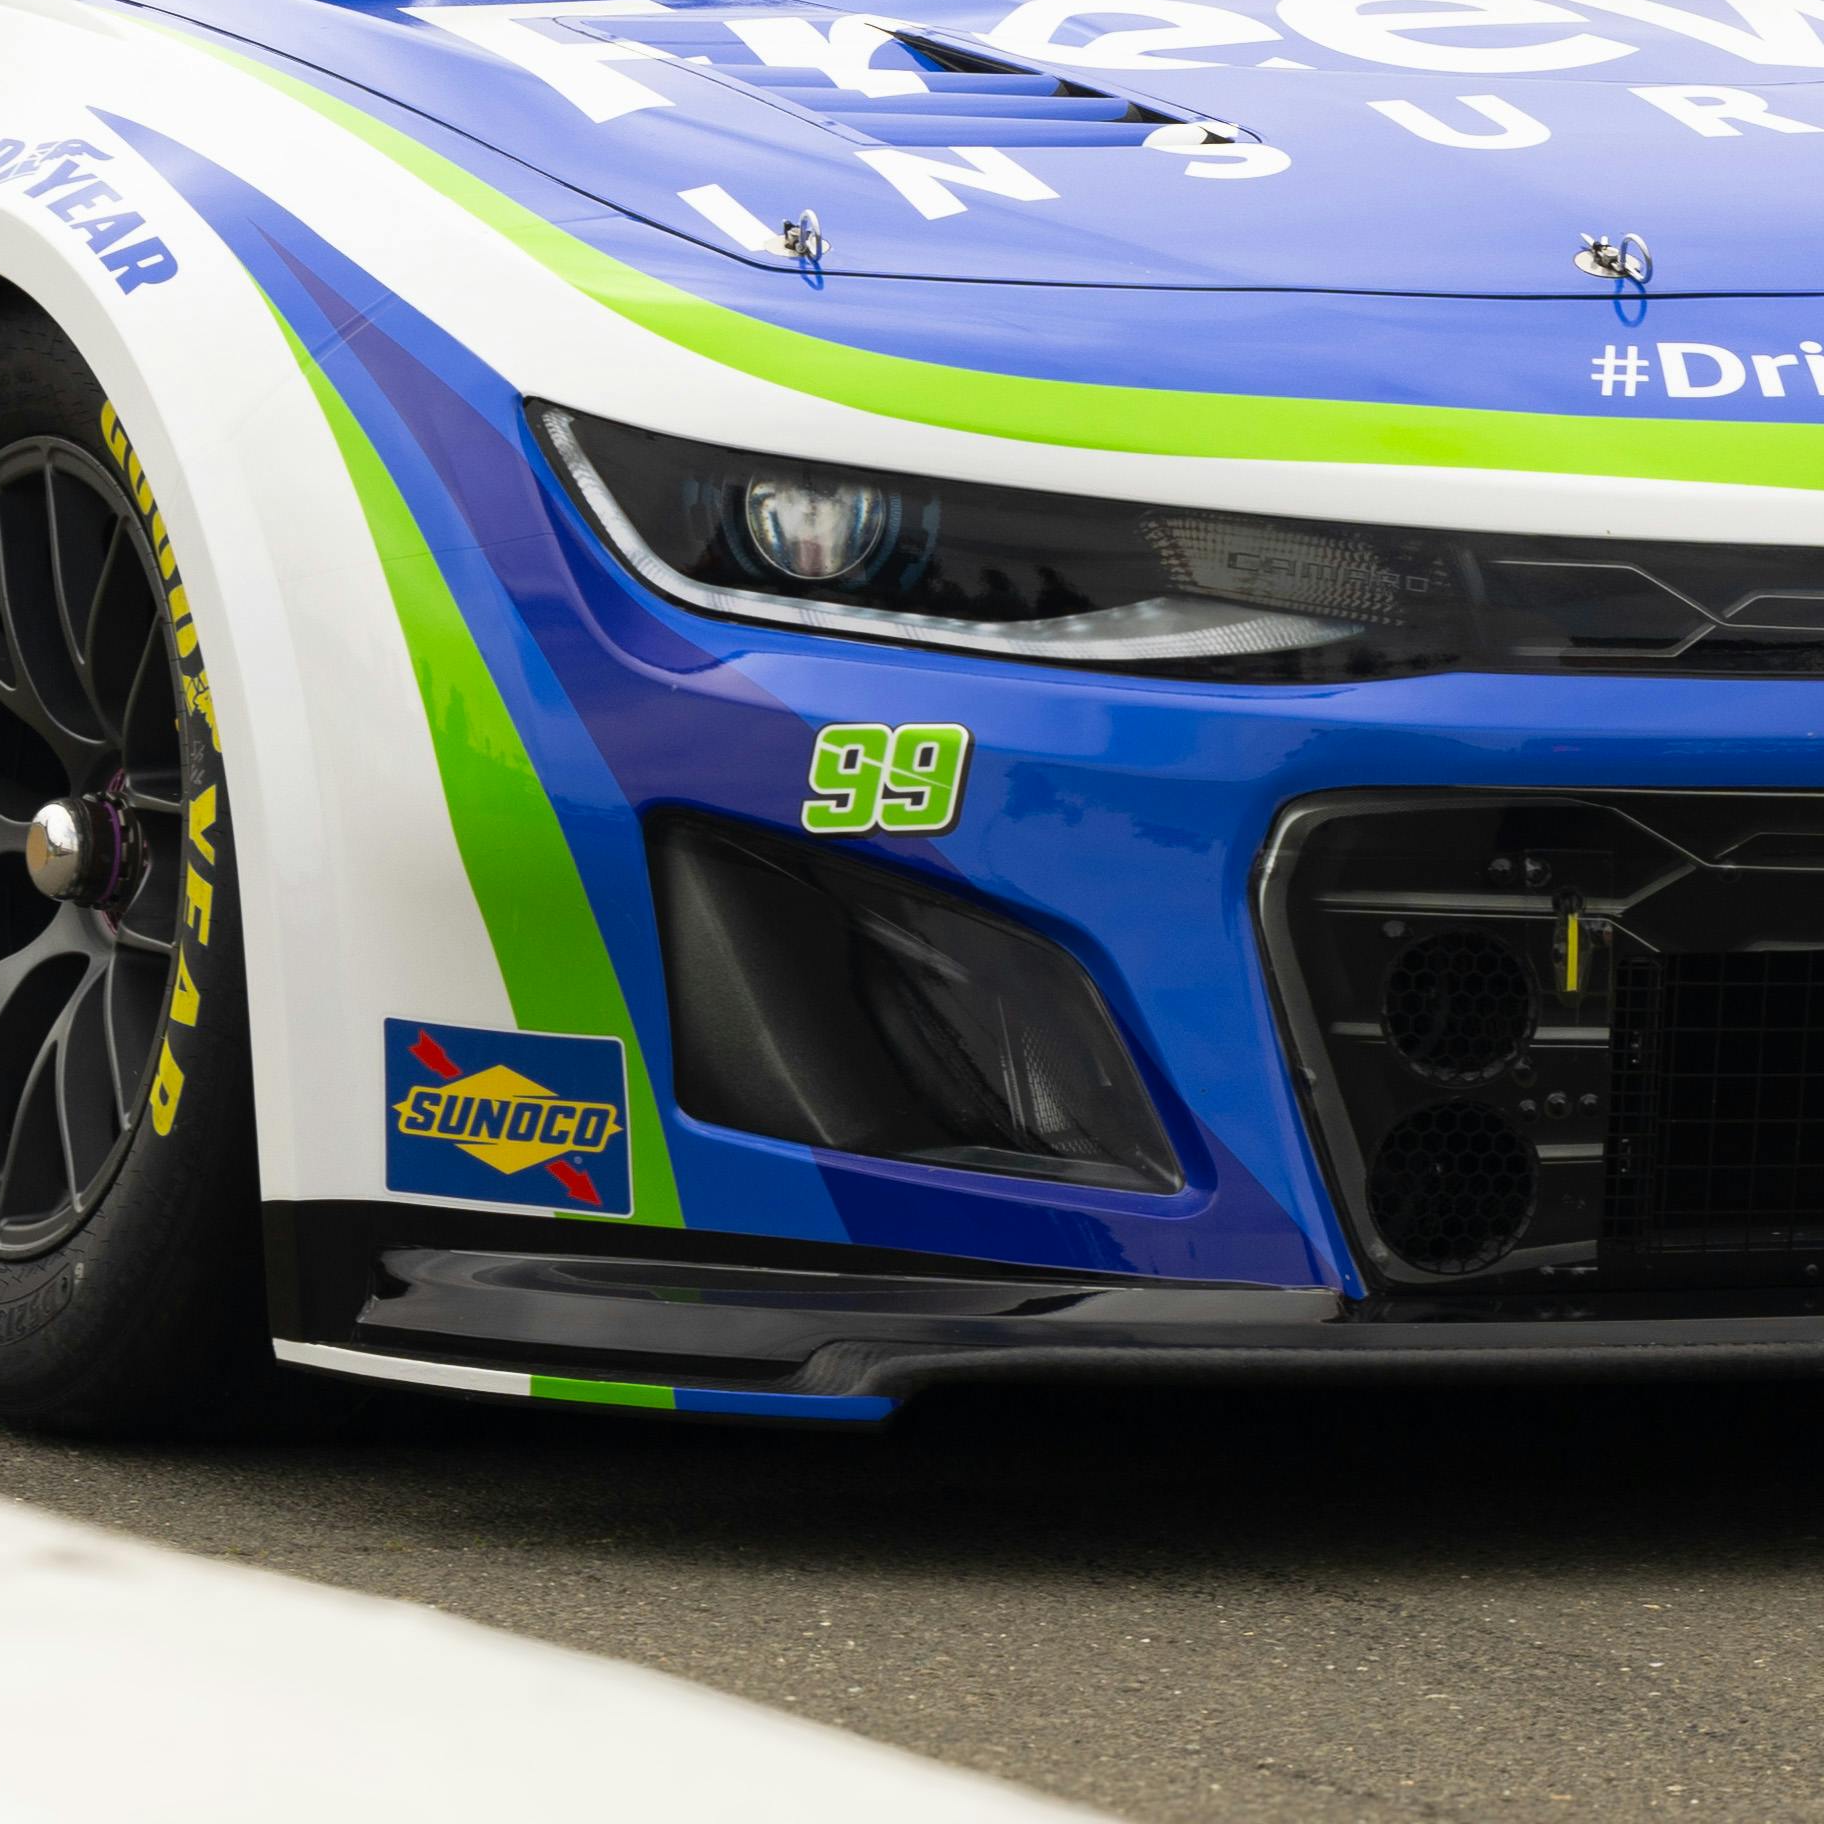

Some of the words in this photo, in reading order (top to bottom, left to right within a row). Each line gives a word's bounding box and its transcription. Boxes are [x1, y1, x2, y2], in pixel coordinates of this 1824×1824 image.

[1228, 550, 1428, 593] CAMARO
[801, 721, 971, 836] 99
[405, 1090, 614, 1150] SUNOCO
